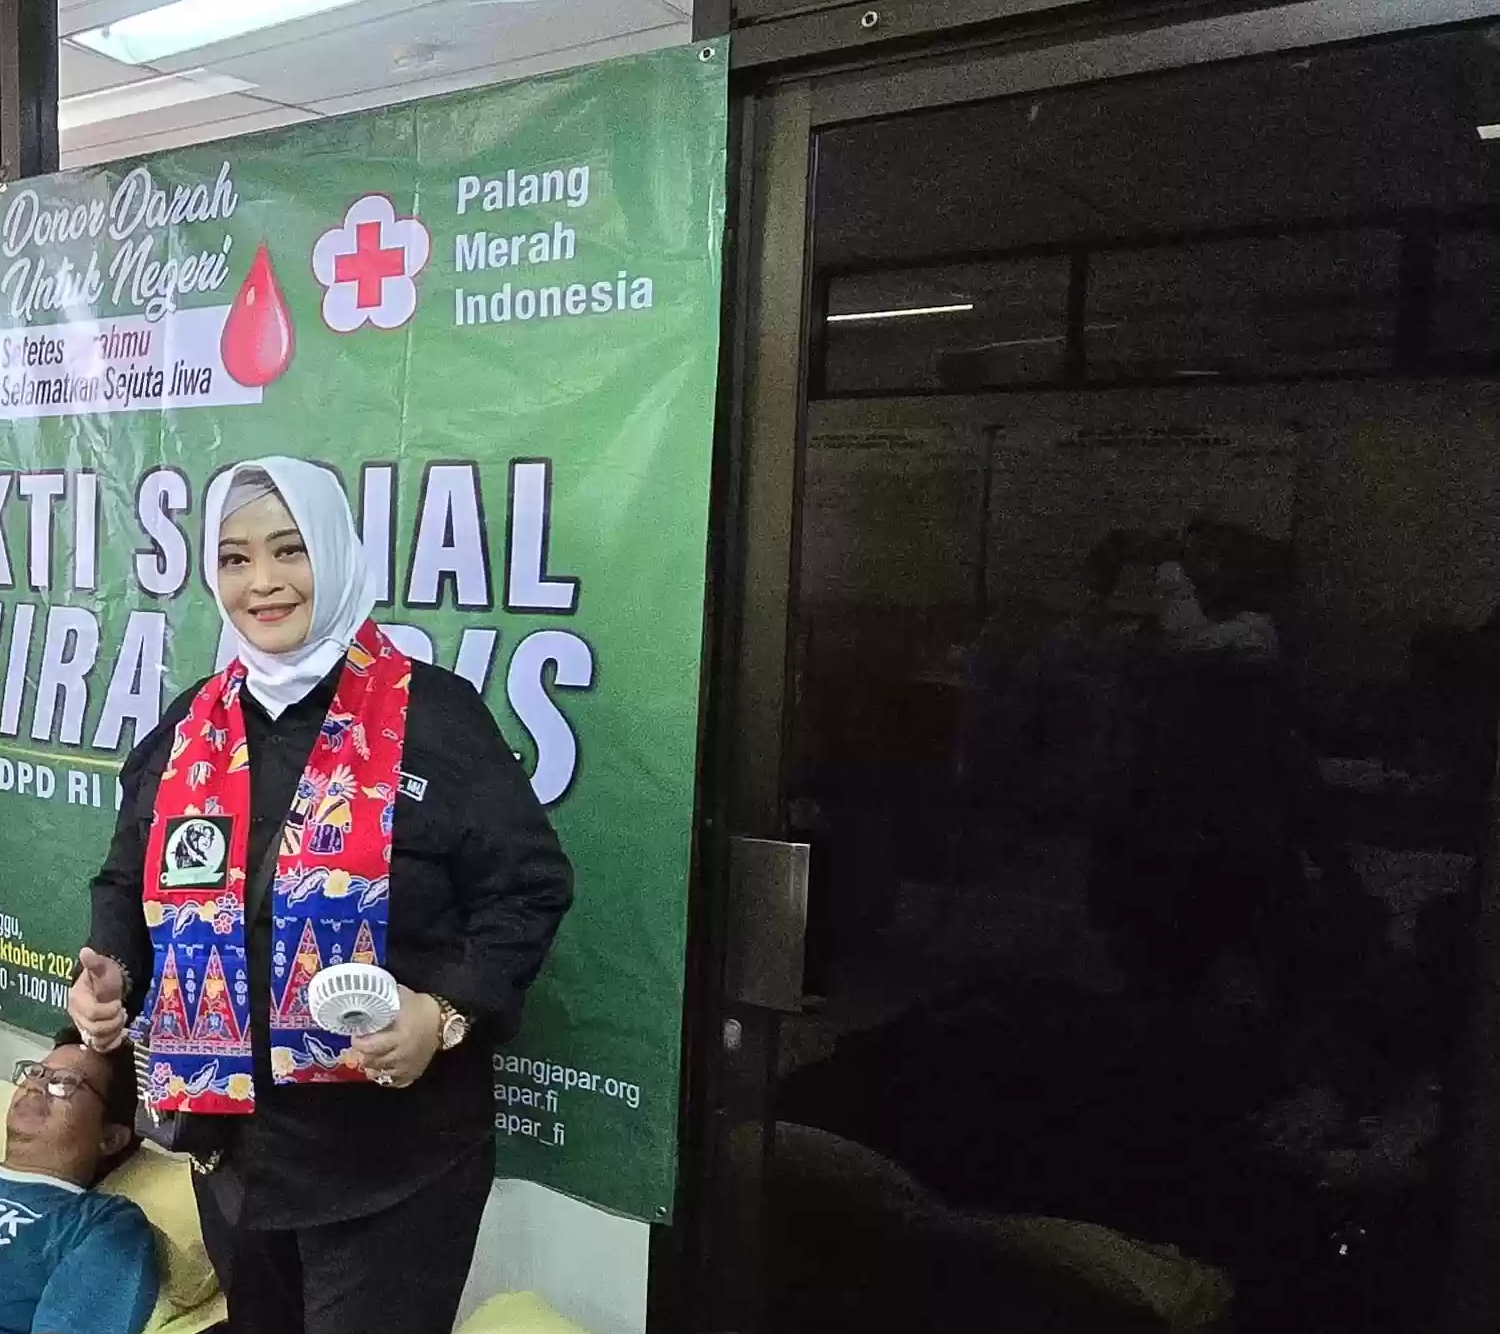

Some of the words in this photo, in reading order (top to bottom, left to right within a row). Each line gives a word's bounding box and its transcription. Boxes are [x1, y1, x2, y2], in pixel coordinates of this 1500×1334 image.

[2, 188, 105, 258] Donor
[109, 161, 239, 240] Darah
[456, 165, 590, 215] Palang
[455, 220, 576, 272] Merah
[1, 251, 105, 322] Untuk
[109, 234, 232, 323] Negeri
[455, 270, 653, 326] Indonesia
[1, 369, 99, 407] Selamatkan
[104, 364, 164, 408] Sejuta
[168, 360, 213, 397] Jiwa
[135, 463, 578, 609] SIAL
[67, 770, 101, 808] RI
[17, 973, 48, 1003] 11.00
[51, 982, 67, 1009] WI
[47, 952, 78, 981] 202
